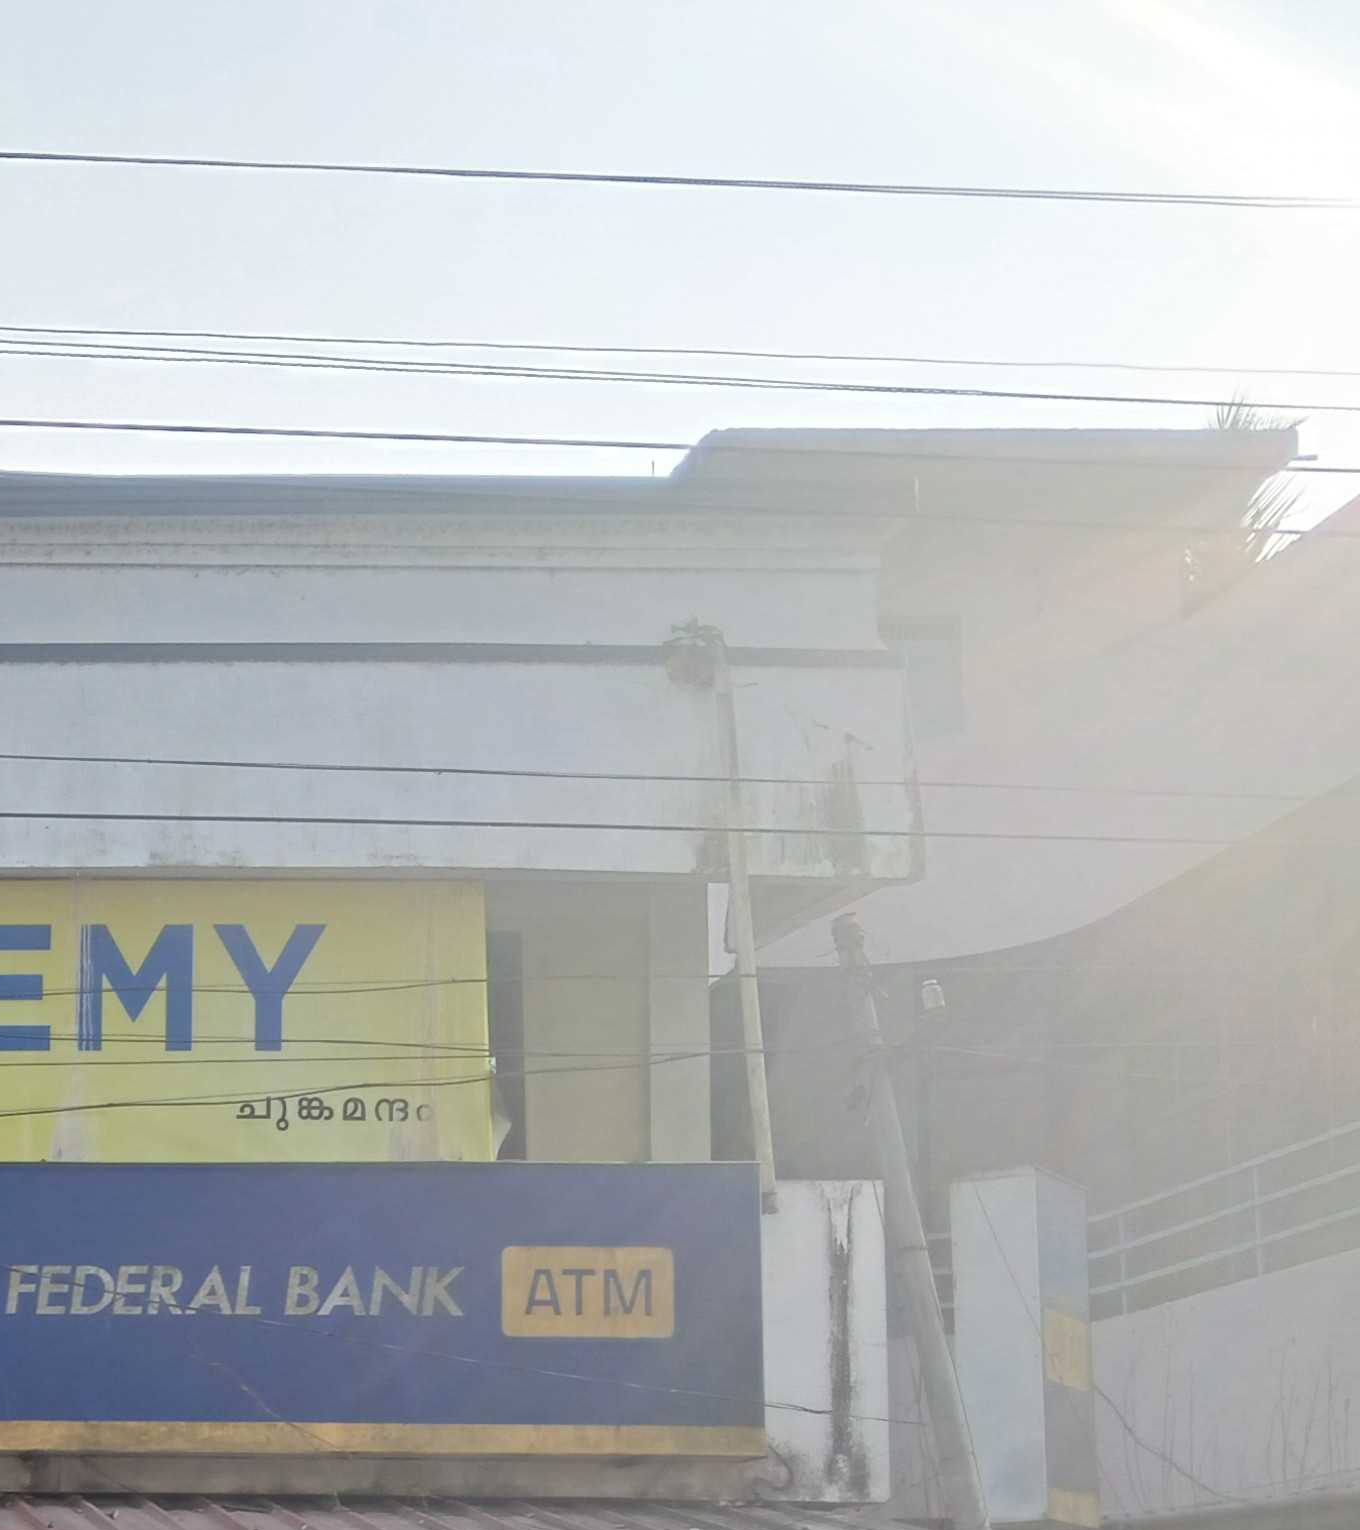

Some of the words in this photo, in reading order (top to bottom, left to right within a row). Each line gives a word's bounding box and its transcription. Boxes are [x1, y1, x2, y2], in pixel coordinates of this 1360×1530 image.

[4, 1264, 264, 1316] FEDERAL
[283, 1265, 467, 1317] BANK
[524, 1267, 656, 1318] ATM
